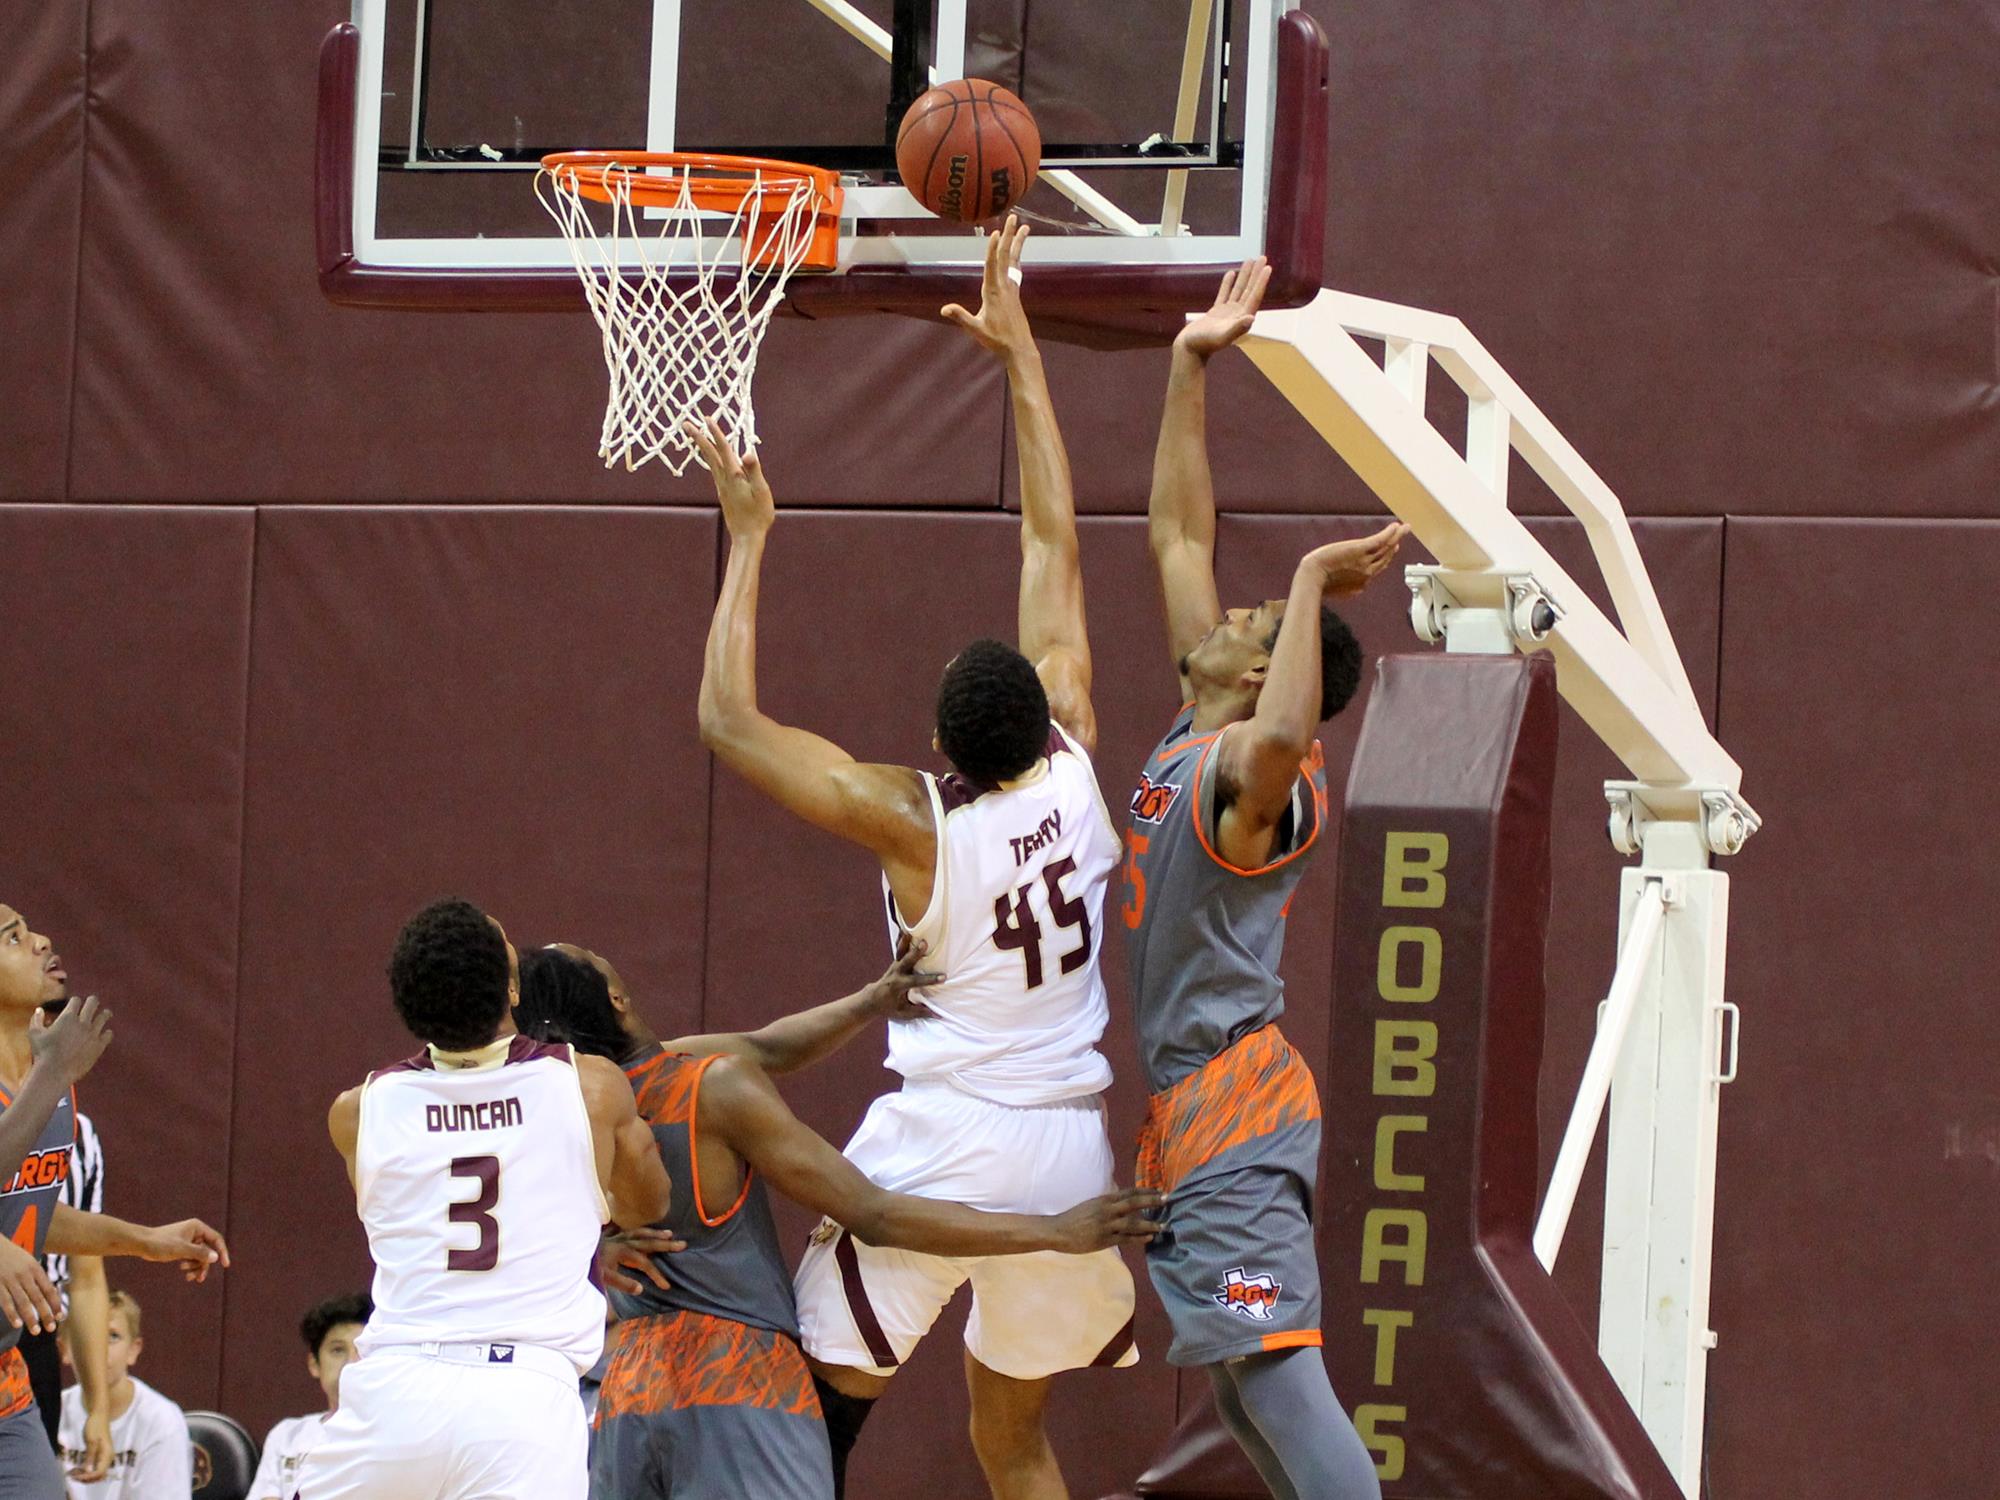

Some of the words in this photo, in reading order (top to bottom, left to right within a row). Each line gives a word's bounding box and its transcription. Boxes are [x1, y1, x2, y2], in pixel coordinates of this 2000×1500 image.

[938, 154, 968, 222] ilson
[1009, 808, 1061, 867] TERRY
[1122, 827, 1150, 930] 5
[992, 855, 1091, 990] 45
[426, 1097, 523, 1132] DUNCAN
[2, 1147, 72, 1192] RGV
[1353, 831, 1449, 1480] BOBCATS
[447, 1155, 500, 1271] 3
[1226, 1281, 1280, 1307] RGV
